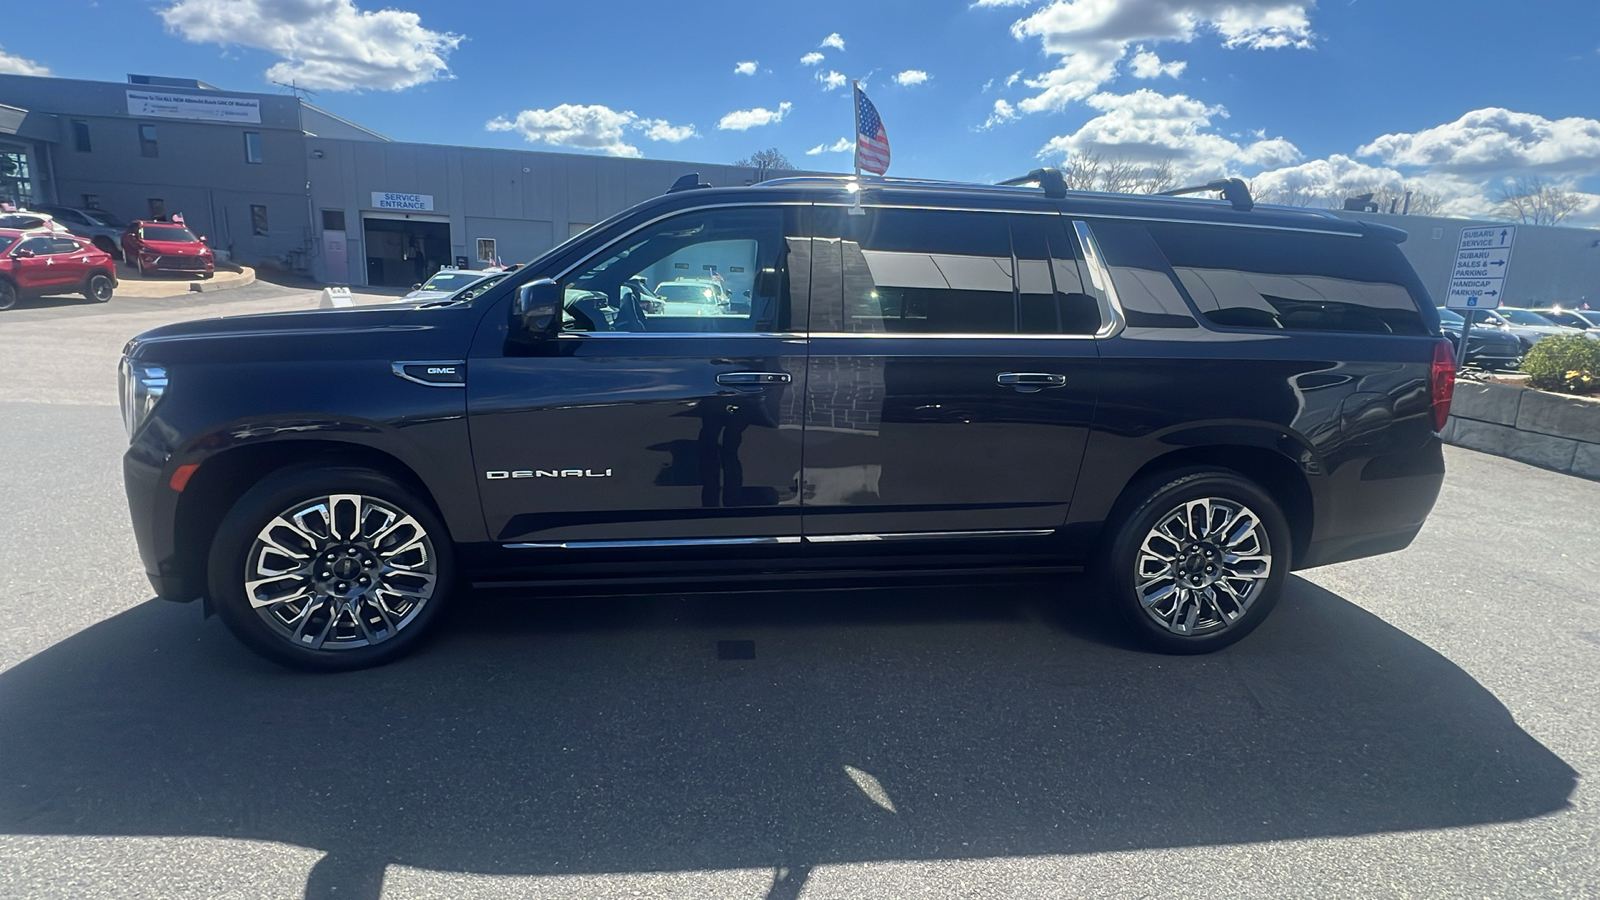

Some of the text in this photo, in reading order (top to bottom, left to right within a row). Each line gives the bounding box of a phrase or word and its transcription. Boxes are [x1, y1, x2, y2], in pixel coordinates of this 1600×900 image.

[385, 194, 420, 202] SERVICE
[380, 201, 425, 209] ENTRANCE
[1463, 230, 1494, 238] SUBARU
[486, 469, 612, 480] DENALI
